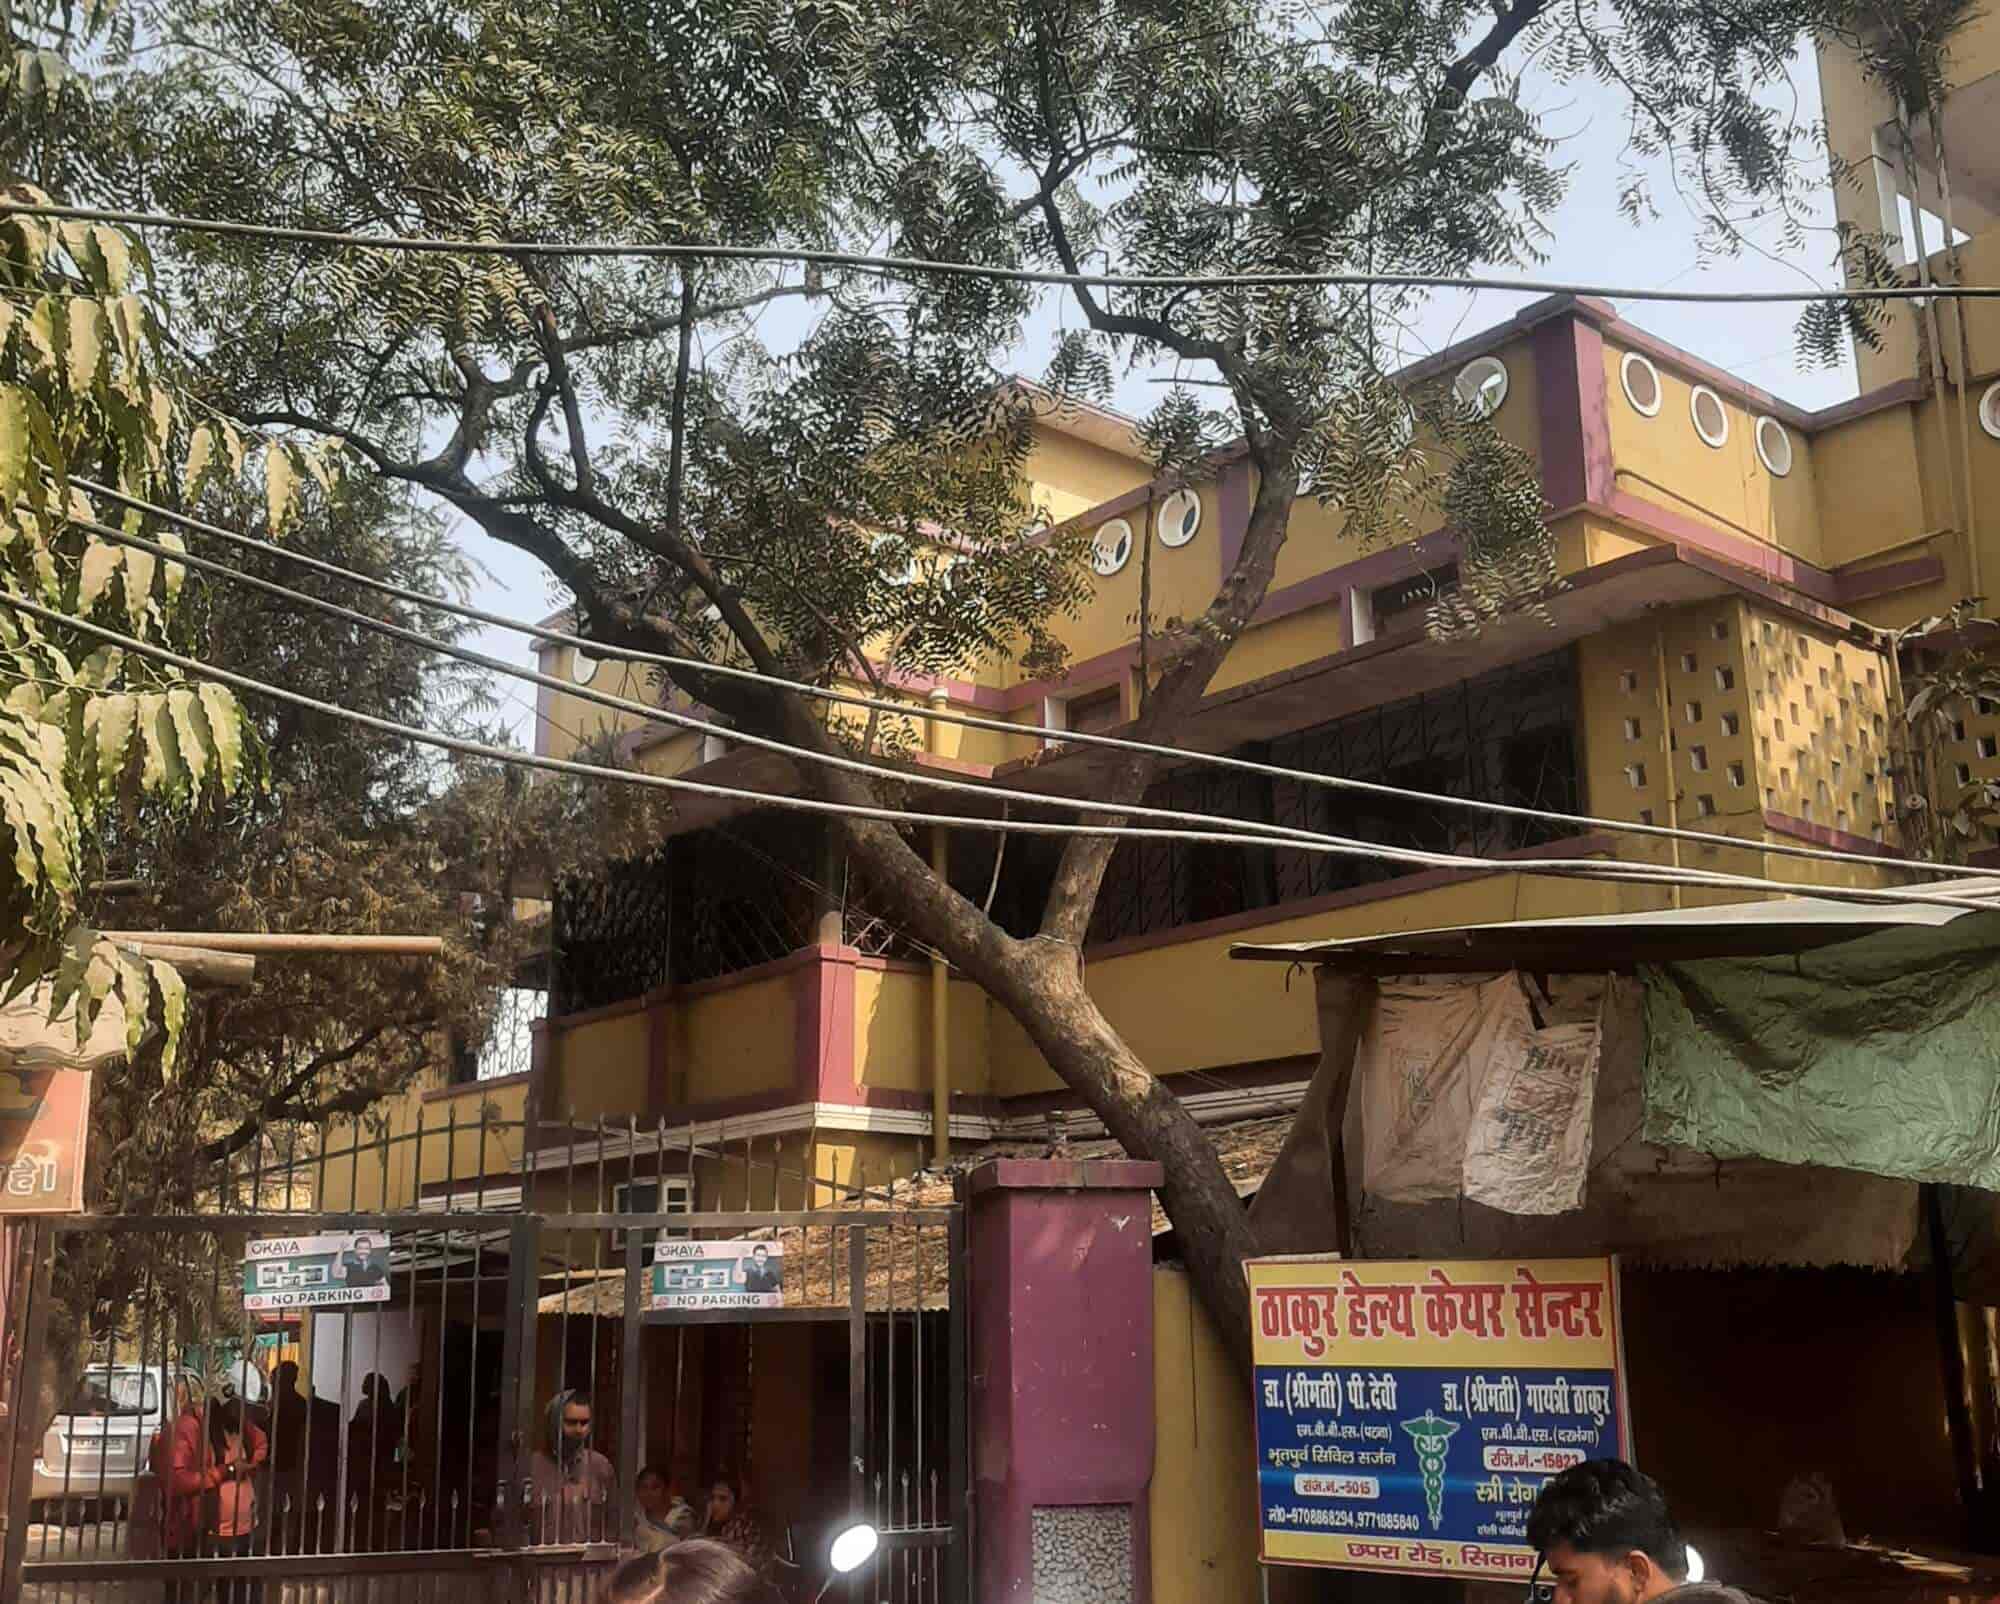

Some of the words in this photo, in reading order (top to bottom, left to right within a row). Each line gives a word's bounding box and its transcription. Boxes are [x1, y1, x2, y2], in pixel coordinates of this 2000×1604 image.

[251, 1240, 300, 1256] OKAYA
[659, 1244, 704, 1257] OKAYA
[271, 1293, 296, 1306] NO
[299, 1289, 364, 1304] PARKING
[676, 1294, 697, 1306] NO
[701, 1294, 761, 1305] PARKING
[1256, 1286, 1339, 1358] ठाकुर
[1421, 1268, 1505, 1338] केयर
[1511, 1267, 1604, 1338] सेन्टर
[1525, 1376, 1570, 1415] गायत्री
[1571, 1385, 1612, 1427] ठाकुर
[1312, 1444, 1355, 1465] सिविल
[1358, 1448, 1397, 1466] सर्जन
[1476, 1473, 1504, 1504] स्त्री
[1347, 1542, 1400, 1561] छपरा
[1460, 1544, 1537, 1570] सिवान
